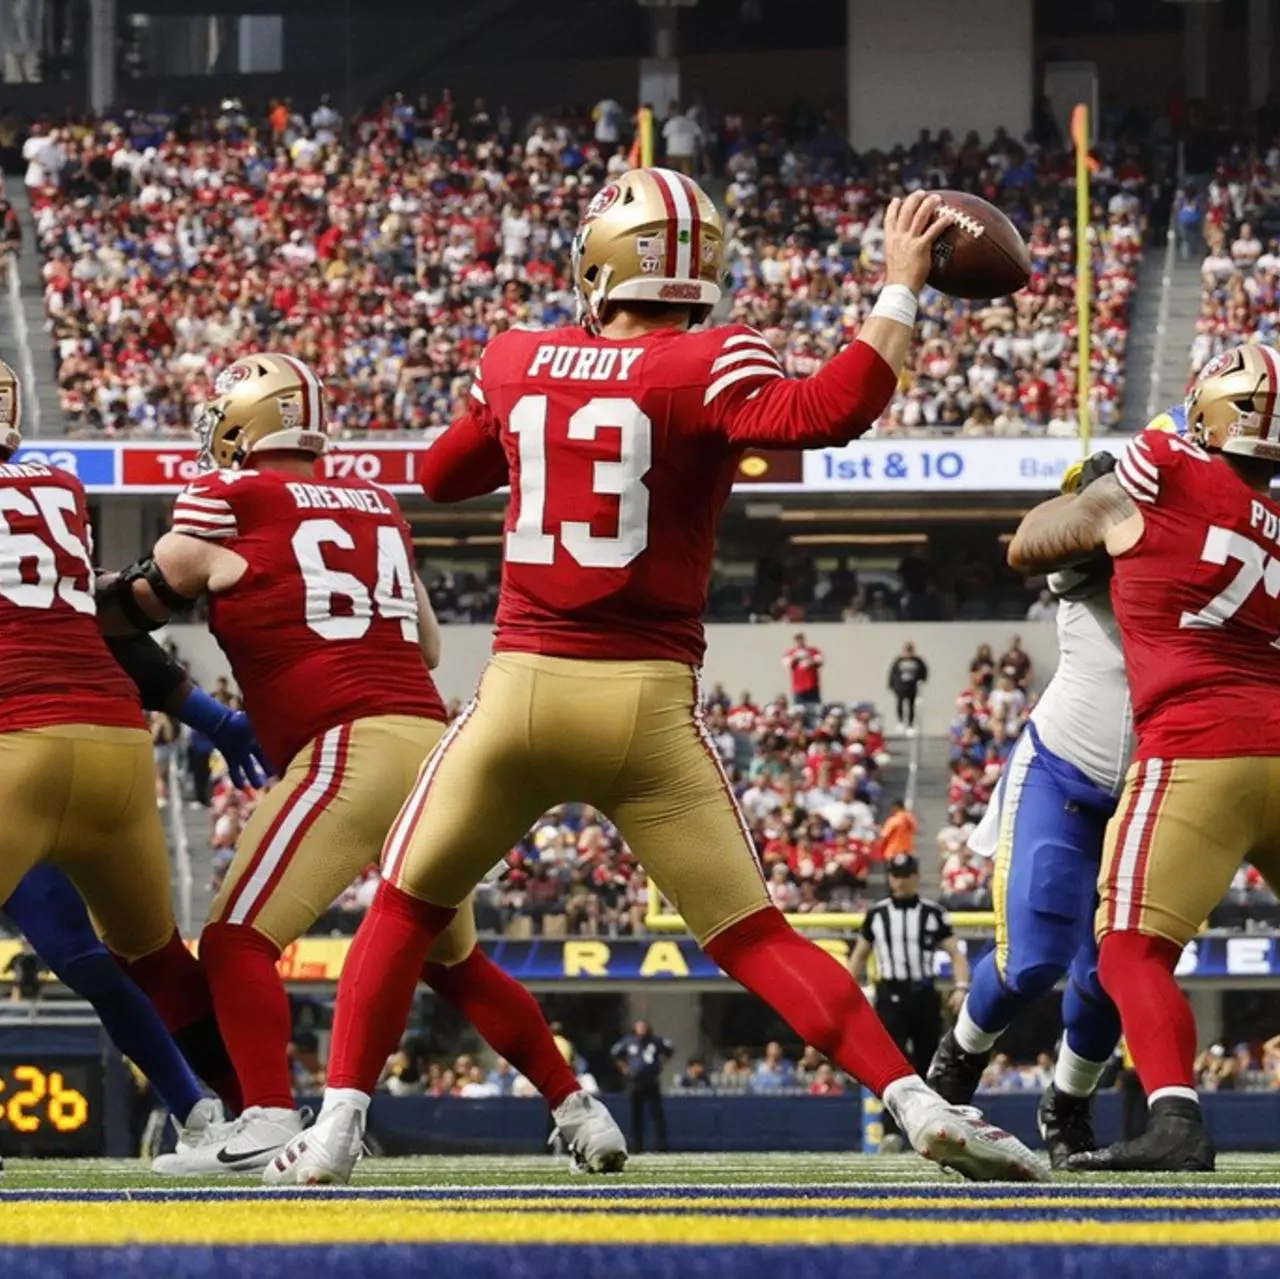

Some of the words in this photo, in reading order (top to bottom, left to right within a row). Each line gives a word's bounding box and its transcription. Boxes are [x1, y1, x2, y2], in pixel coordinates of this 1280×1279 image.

[527, 345, 644, 380] PURDY
[324, 455, 381, 479] 170
[505, 394, 651, 568] 13
[824, 452, 879, 479] 1st
[884, 452, 908, 479] &
[921, 452, 964, 479] 10
[285, 482, 392, 515] BRENDEL
[291, 518, 420, 644] 64
